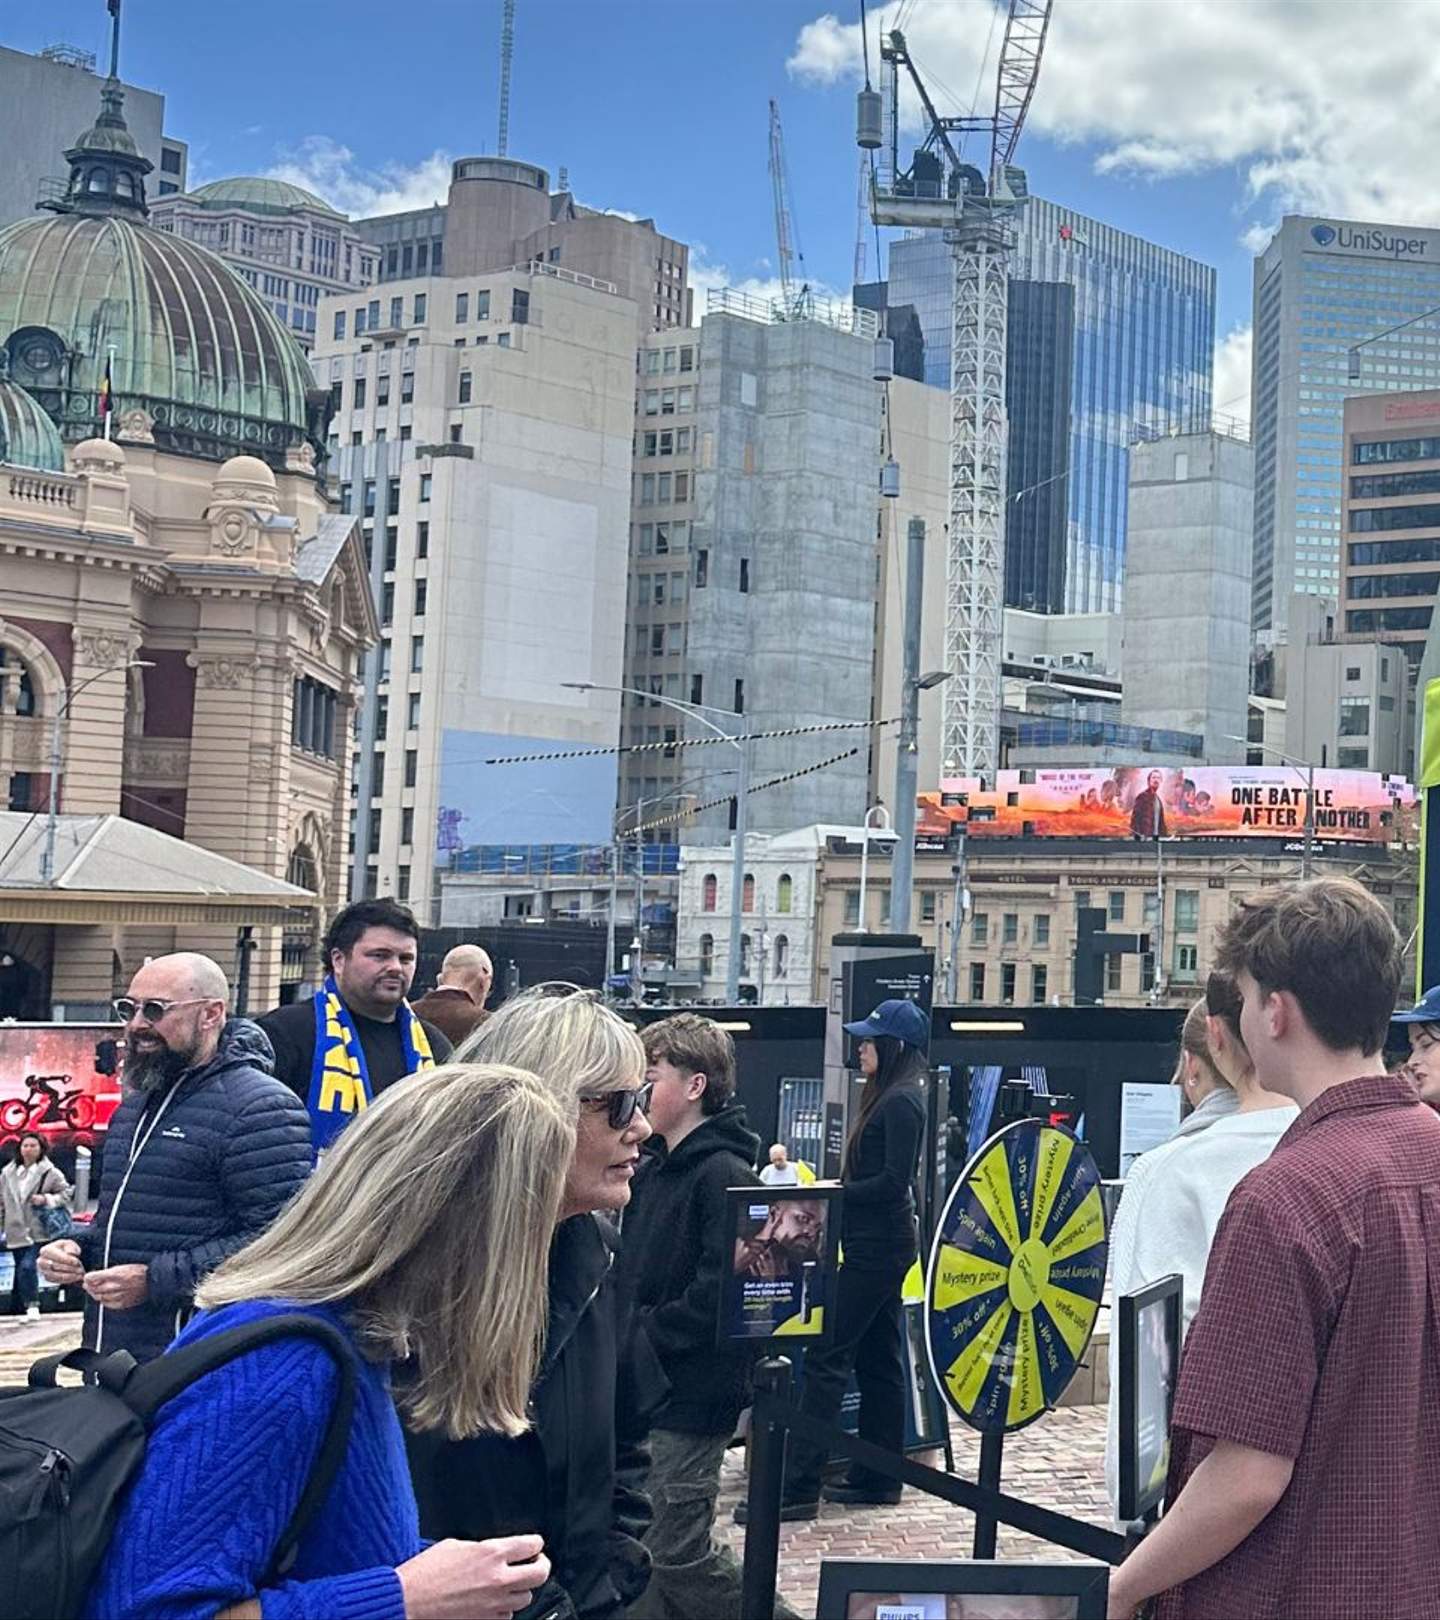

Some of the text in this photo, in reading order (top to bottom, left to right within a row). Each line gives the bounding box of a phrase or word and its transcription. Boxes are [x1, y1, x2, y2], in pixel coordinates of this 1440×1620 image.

[1339, 228, 1428, 257] UniSuper
[1231, 787, 1263, 806] ONE
[1242, 808, 1371, 829] AFTER NOTHER
[1033, 1139, 1060, 1230] Mystery prize
[957, 1208, 976, 1231] Spin
[942, 1272, 977, 1288] Mystery
[978, 1271, 1001, 1286] prize
[951, 1318, 973, 1340] 30%
[1020, 1318, 1030, 1413] Mystery prize
[985, 1384, 1001, 1418] Spin
